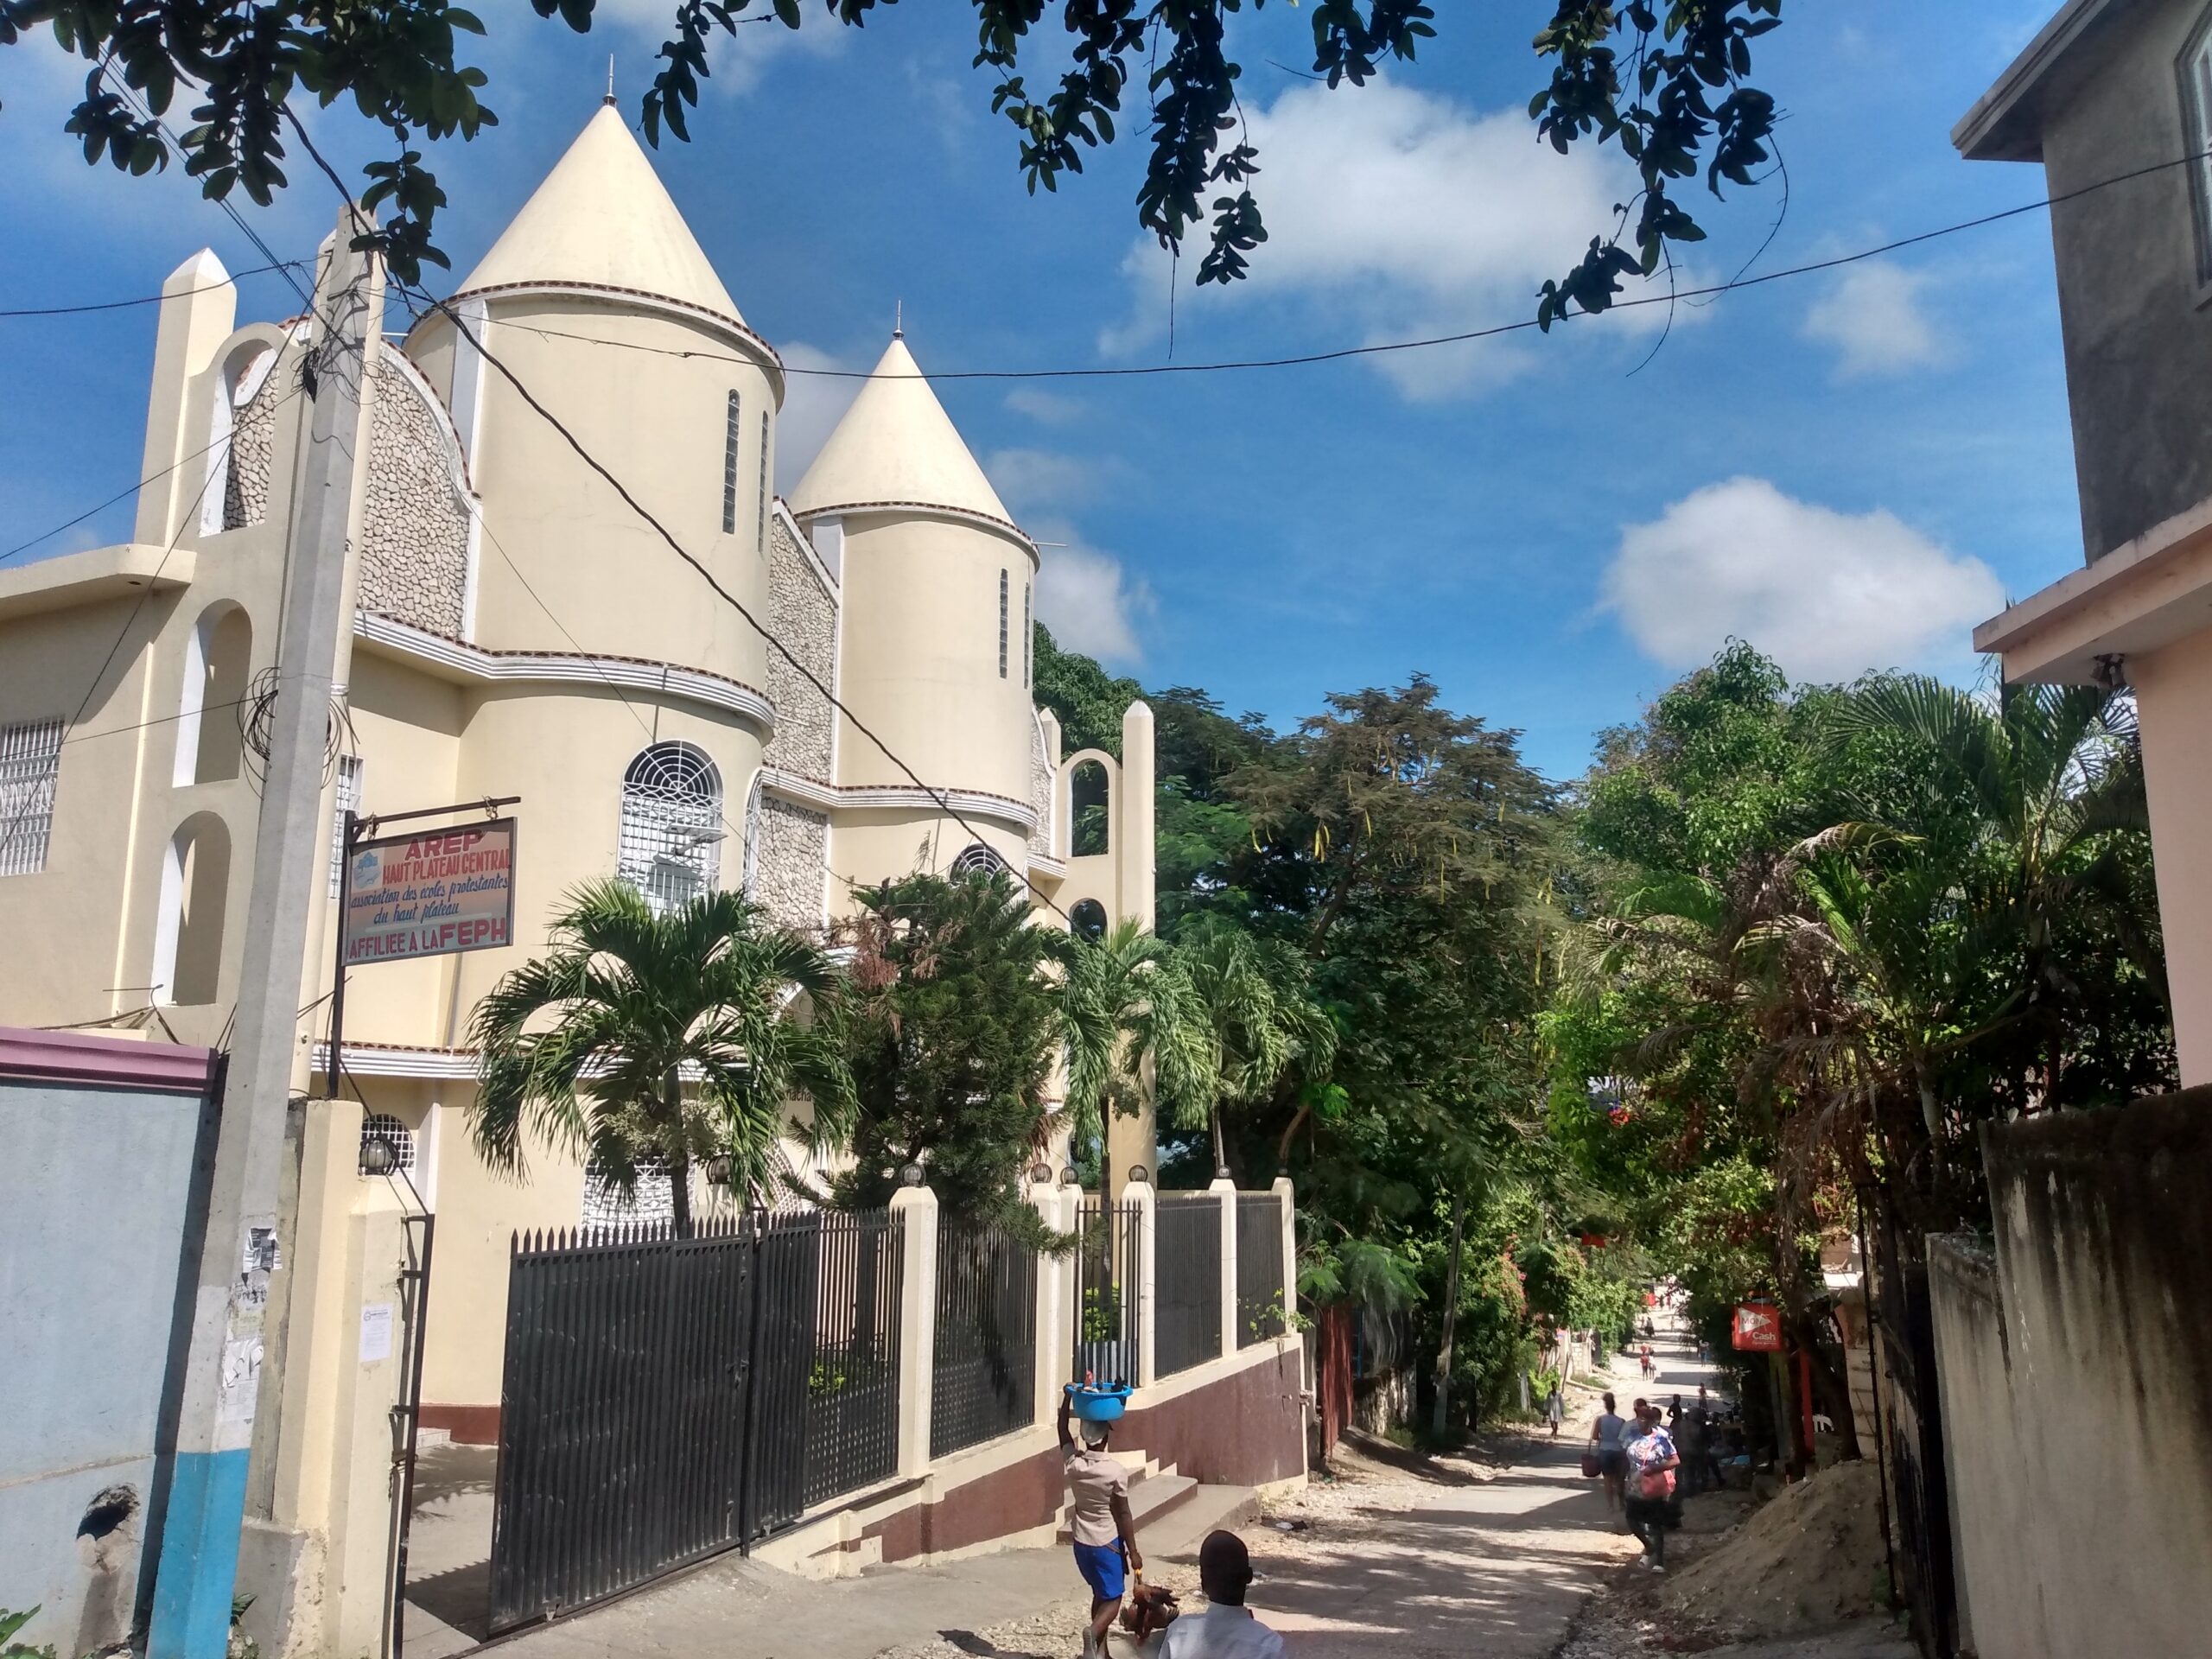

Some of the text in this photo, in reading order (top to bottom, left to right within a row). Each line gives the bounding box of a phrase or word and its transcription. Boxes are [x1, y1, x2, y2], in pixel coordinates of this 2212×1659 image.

[405, 829, 482, 861] AREP
[382, 849, 511, 886] HAUT PLATEAU CENTRAL
[351, 887, 400, 908] association
[402, 885, 417, 900] des
[448, 873, 508, 902] protestantes
[373, 899, 459, 925] du haut plateau
[349, 918, 505, 959] AFFILIEE A LA FEPH
[1752, 1332, 1776, 1340] Cash
